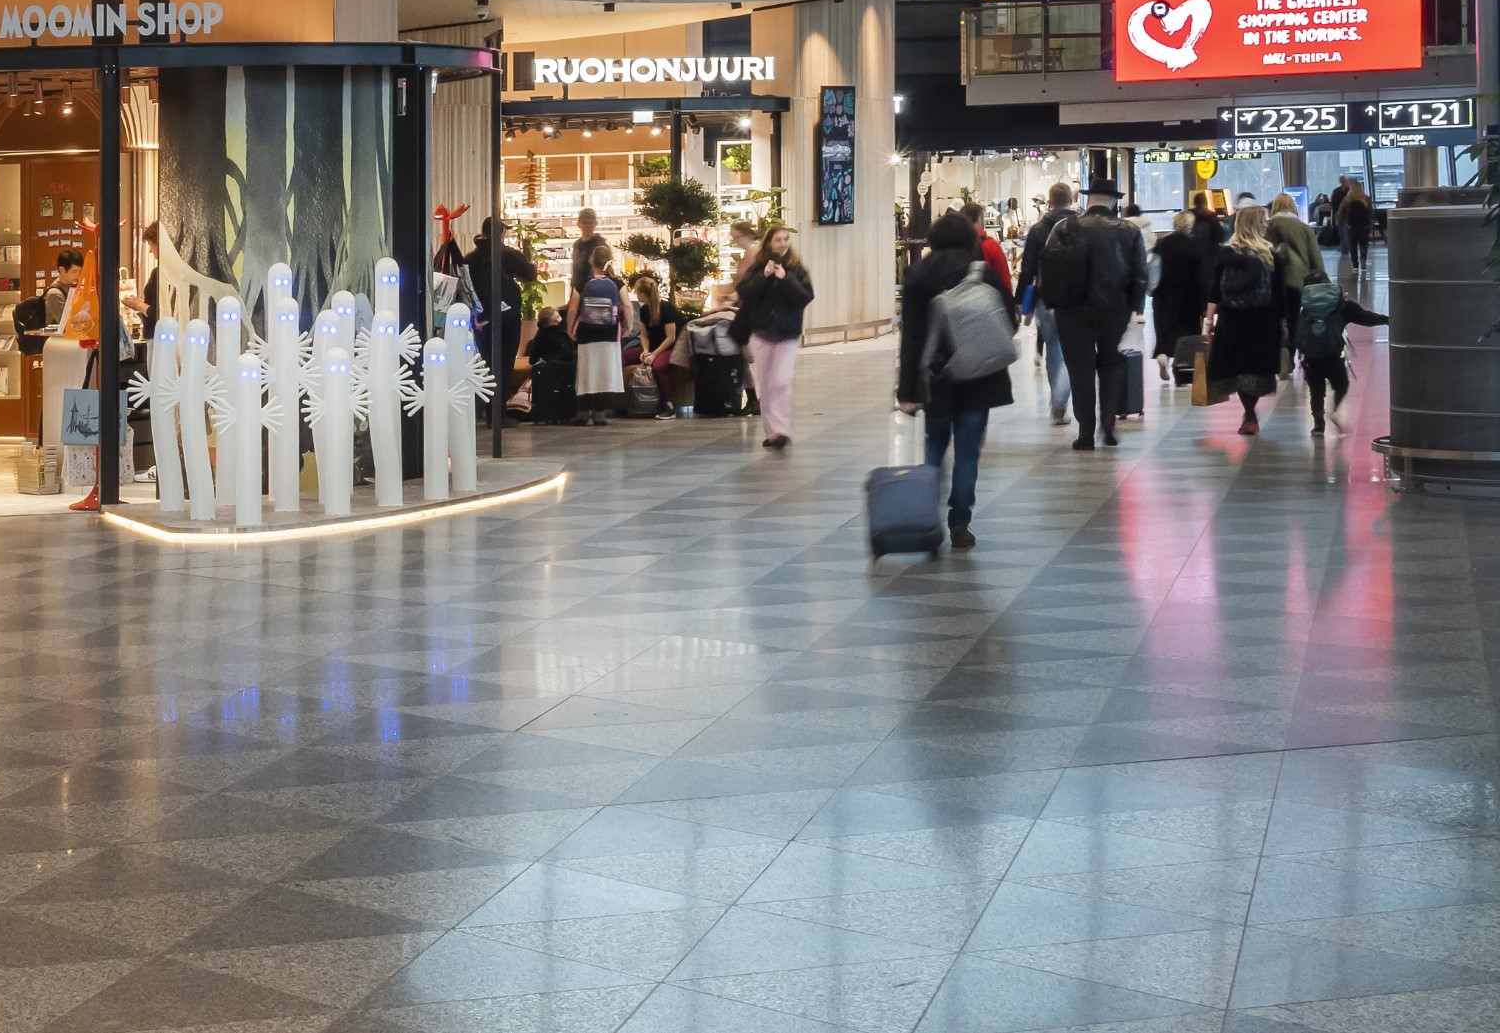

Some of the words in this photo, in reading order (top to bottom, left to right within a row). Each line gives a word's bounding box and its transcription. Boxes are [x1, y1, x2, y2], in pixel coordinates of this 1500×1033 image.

[0, 3, 127, 40] MOOMIN
[137, 2, 224, 36] SHOP
[1237, 12, 1309, 30] SHOPPING
[1312, 8, 1368, 25] CENTER
[1243, 31, 1260, 46] IN
[1263, 29, 1290, 45] THE
[1294, 26, 1363, 44] NORDICS.
[1292, 52, 1342, 64] TRIPLA
[534, 56, 775, 84] RUOHONJUURI
[1261, 107, 1338, 132] 22-25
[1407, 102, 1460, 126] 1-21
[1277, 137, 1302, 145] Toilets
[1397, 134, 1424, 142] Lounge
